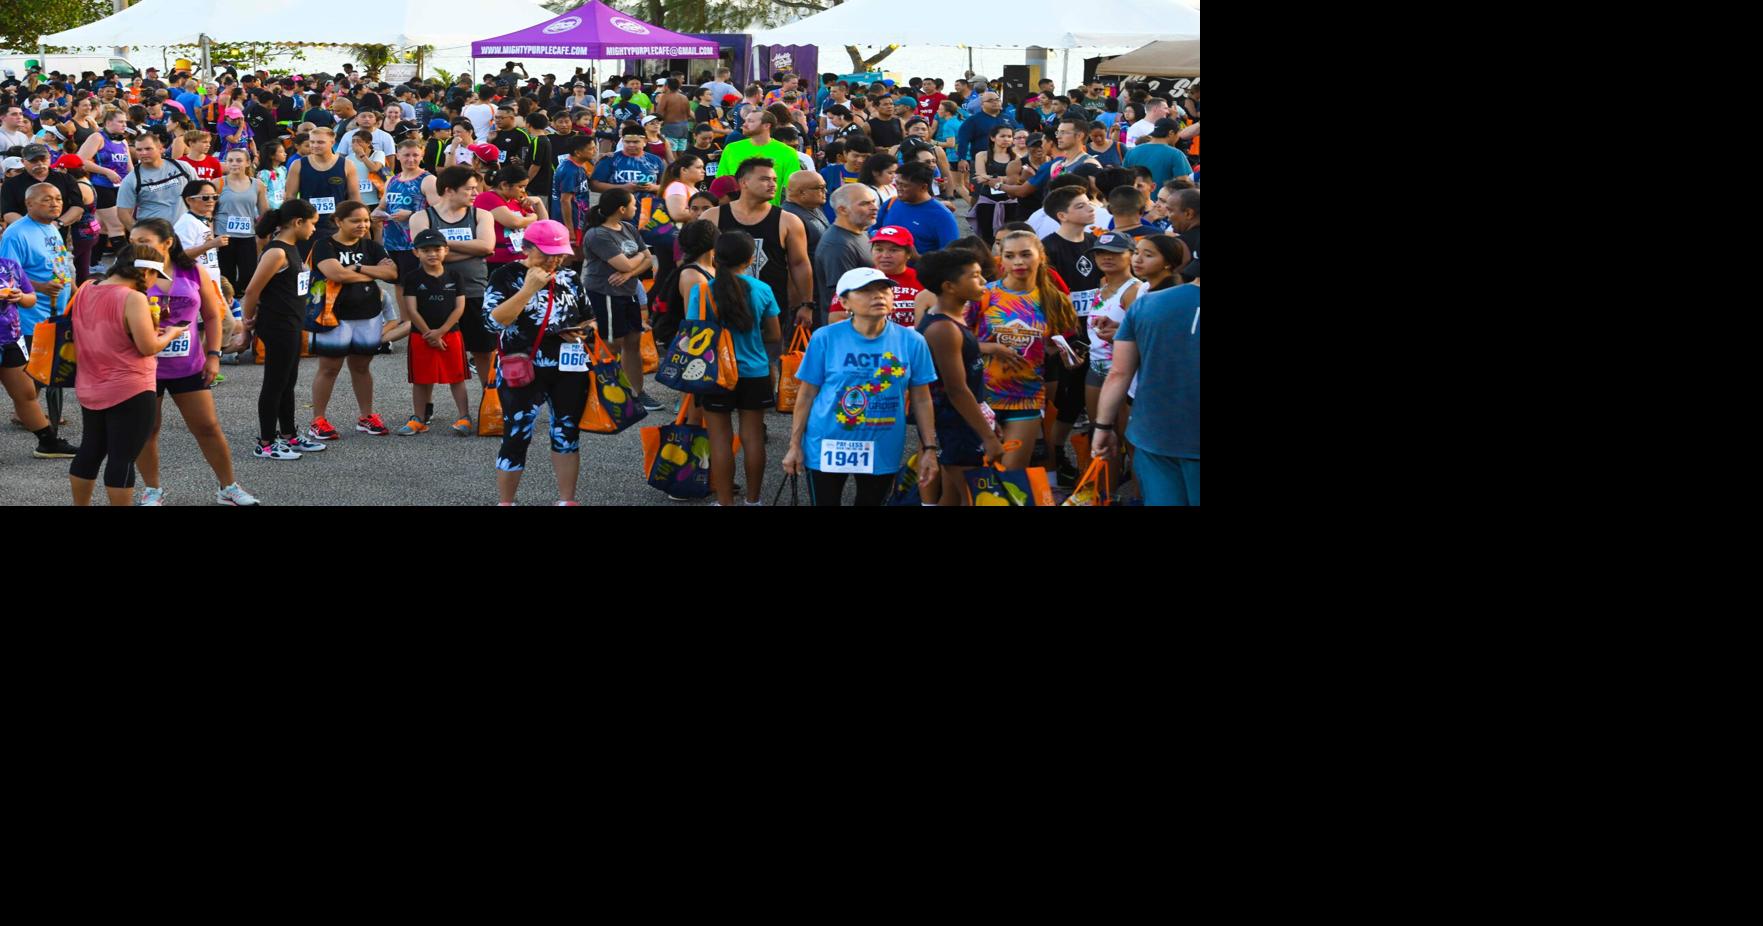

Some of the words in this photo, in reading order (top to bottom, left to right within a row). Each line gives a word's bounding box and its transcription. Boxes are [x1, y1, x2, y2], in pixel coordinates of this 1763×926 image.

[480, 46, 587, 56] WWW.MIGHTYPURPLECAFE.COM
[605, 46, 714, 56] MIGHTYPURPLECAFE@GMAIL.COM
[228, 221, 250, 231] 0739
[162, 340, 189, 352] 269
[843, 353, 882, 368] ACT
[824, 451, 869, 467] 1941
